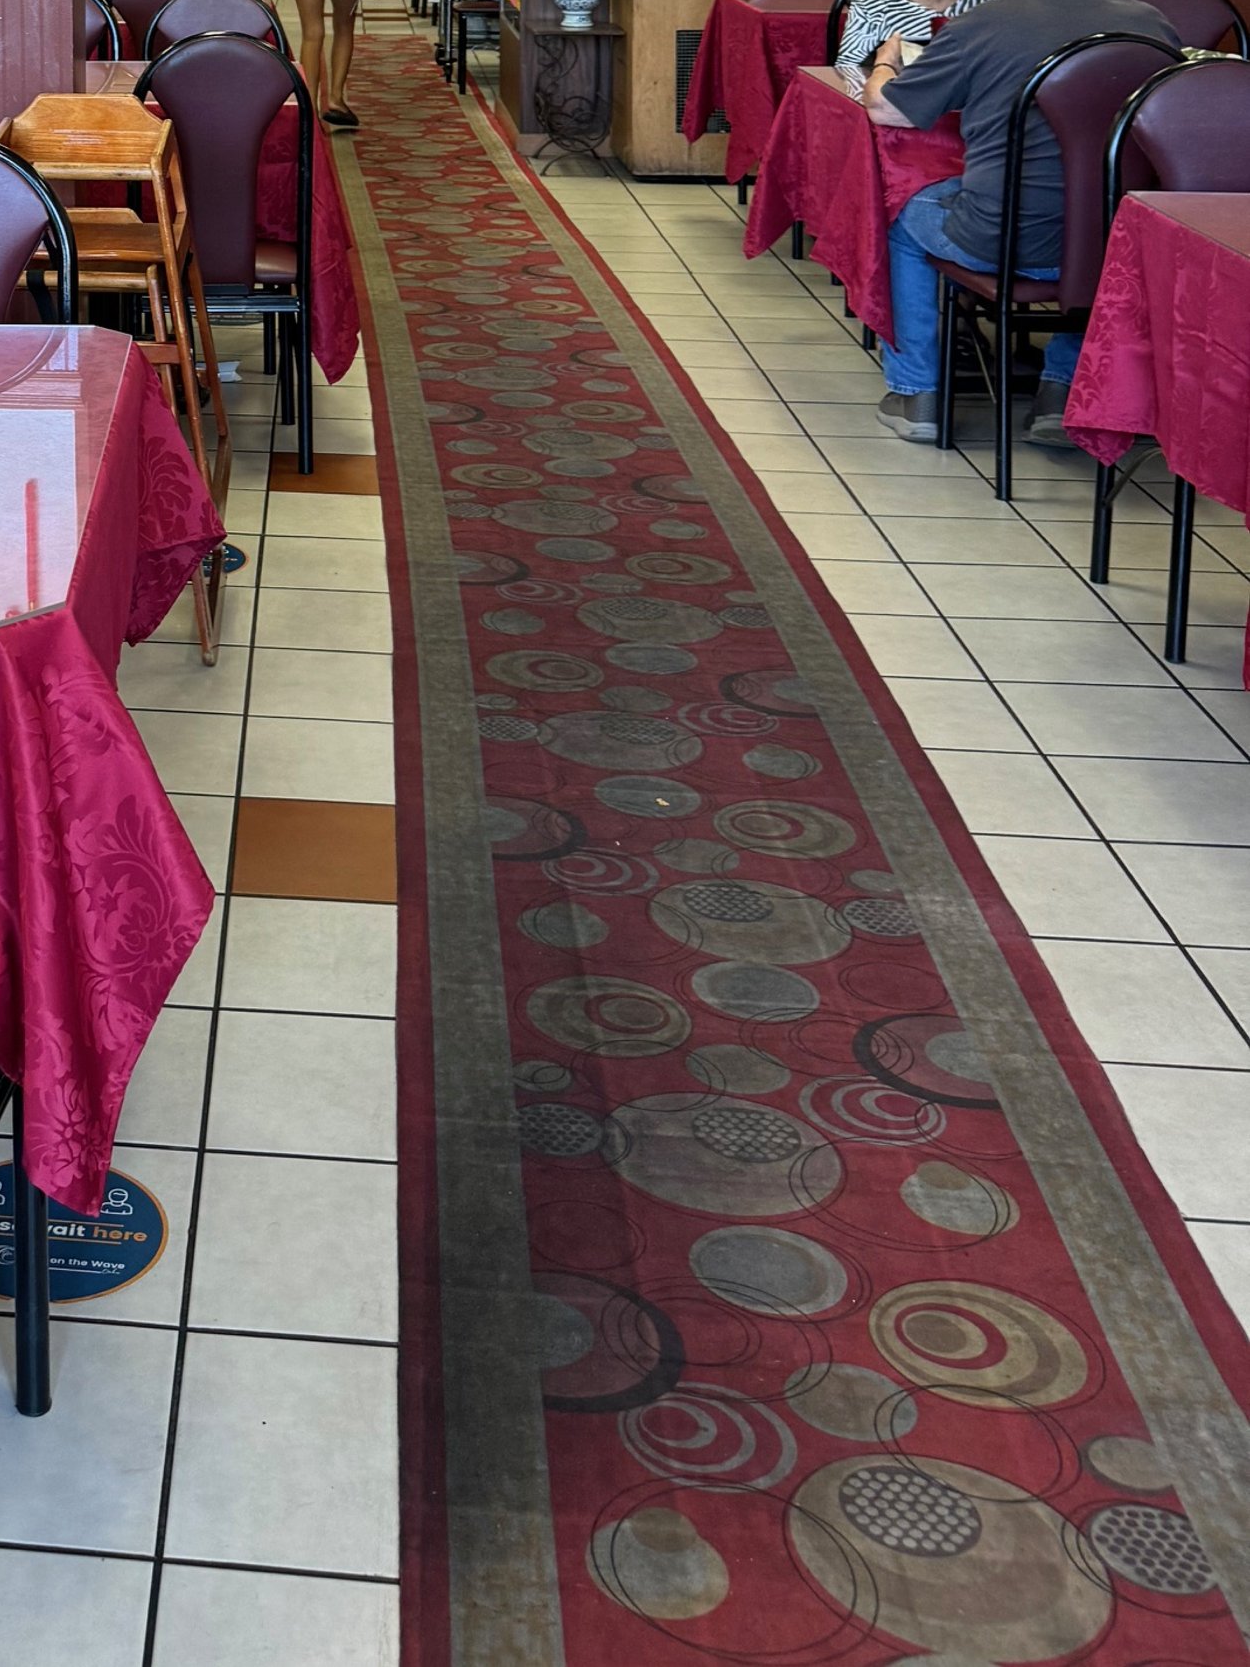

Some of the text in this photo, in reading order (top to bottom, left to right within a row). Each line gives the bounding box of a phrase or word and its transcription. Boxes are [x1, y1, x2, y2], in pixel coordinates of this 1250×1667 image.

[92, 1225, 148, 1242] here
[49, 1257, 126, 1270] on the Wave
